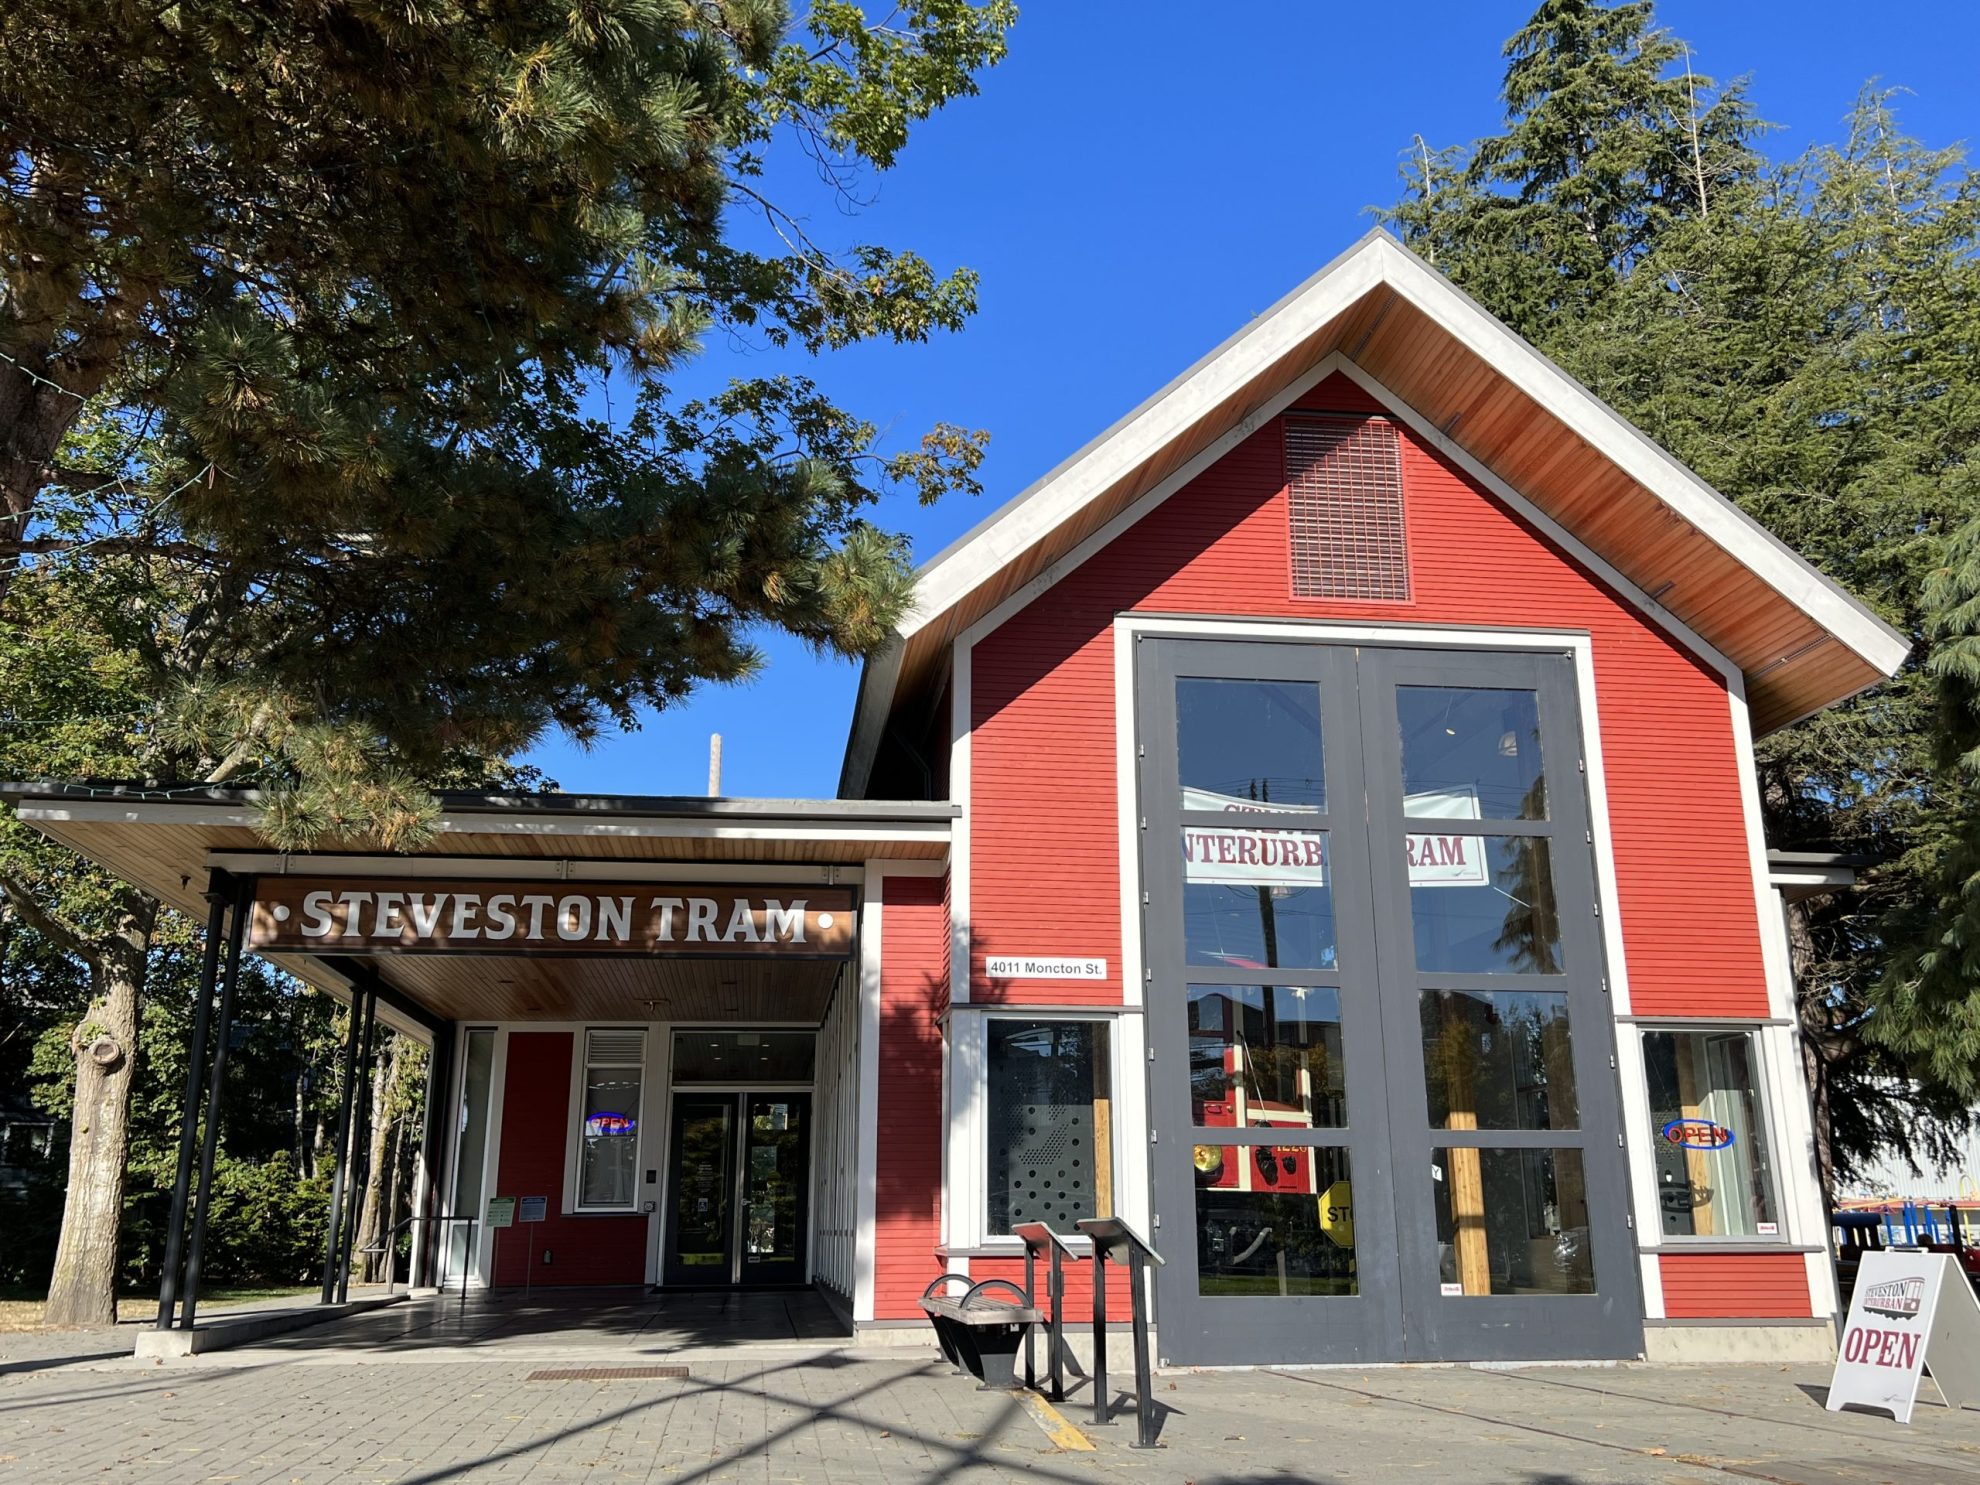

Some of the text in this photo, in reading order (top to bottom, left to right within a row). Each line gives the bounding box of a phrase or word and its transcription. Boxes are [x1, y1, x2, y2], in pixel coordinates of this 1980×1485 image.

[300, 890, 809, 943] STEVESTON TRAM
[990, 961, 1103, 975] 4011 Moncton St.
[590, 1117, 631, 1129] OPEN
[1668, 1126, 1728, 1144] OPEN
[1327, 1206, 1353, 1223] ST
[1844, 1327, 1922, 1370] OPEN
